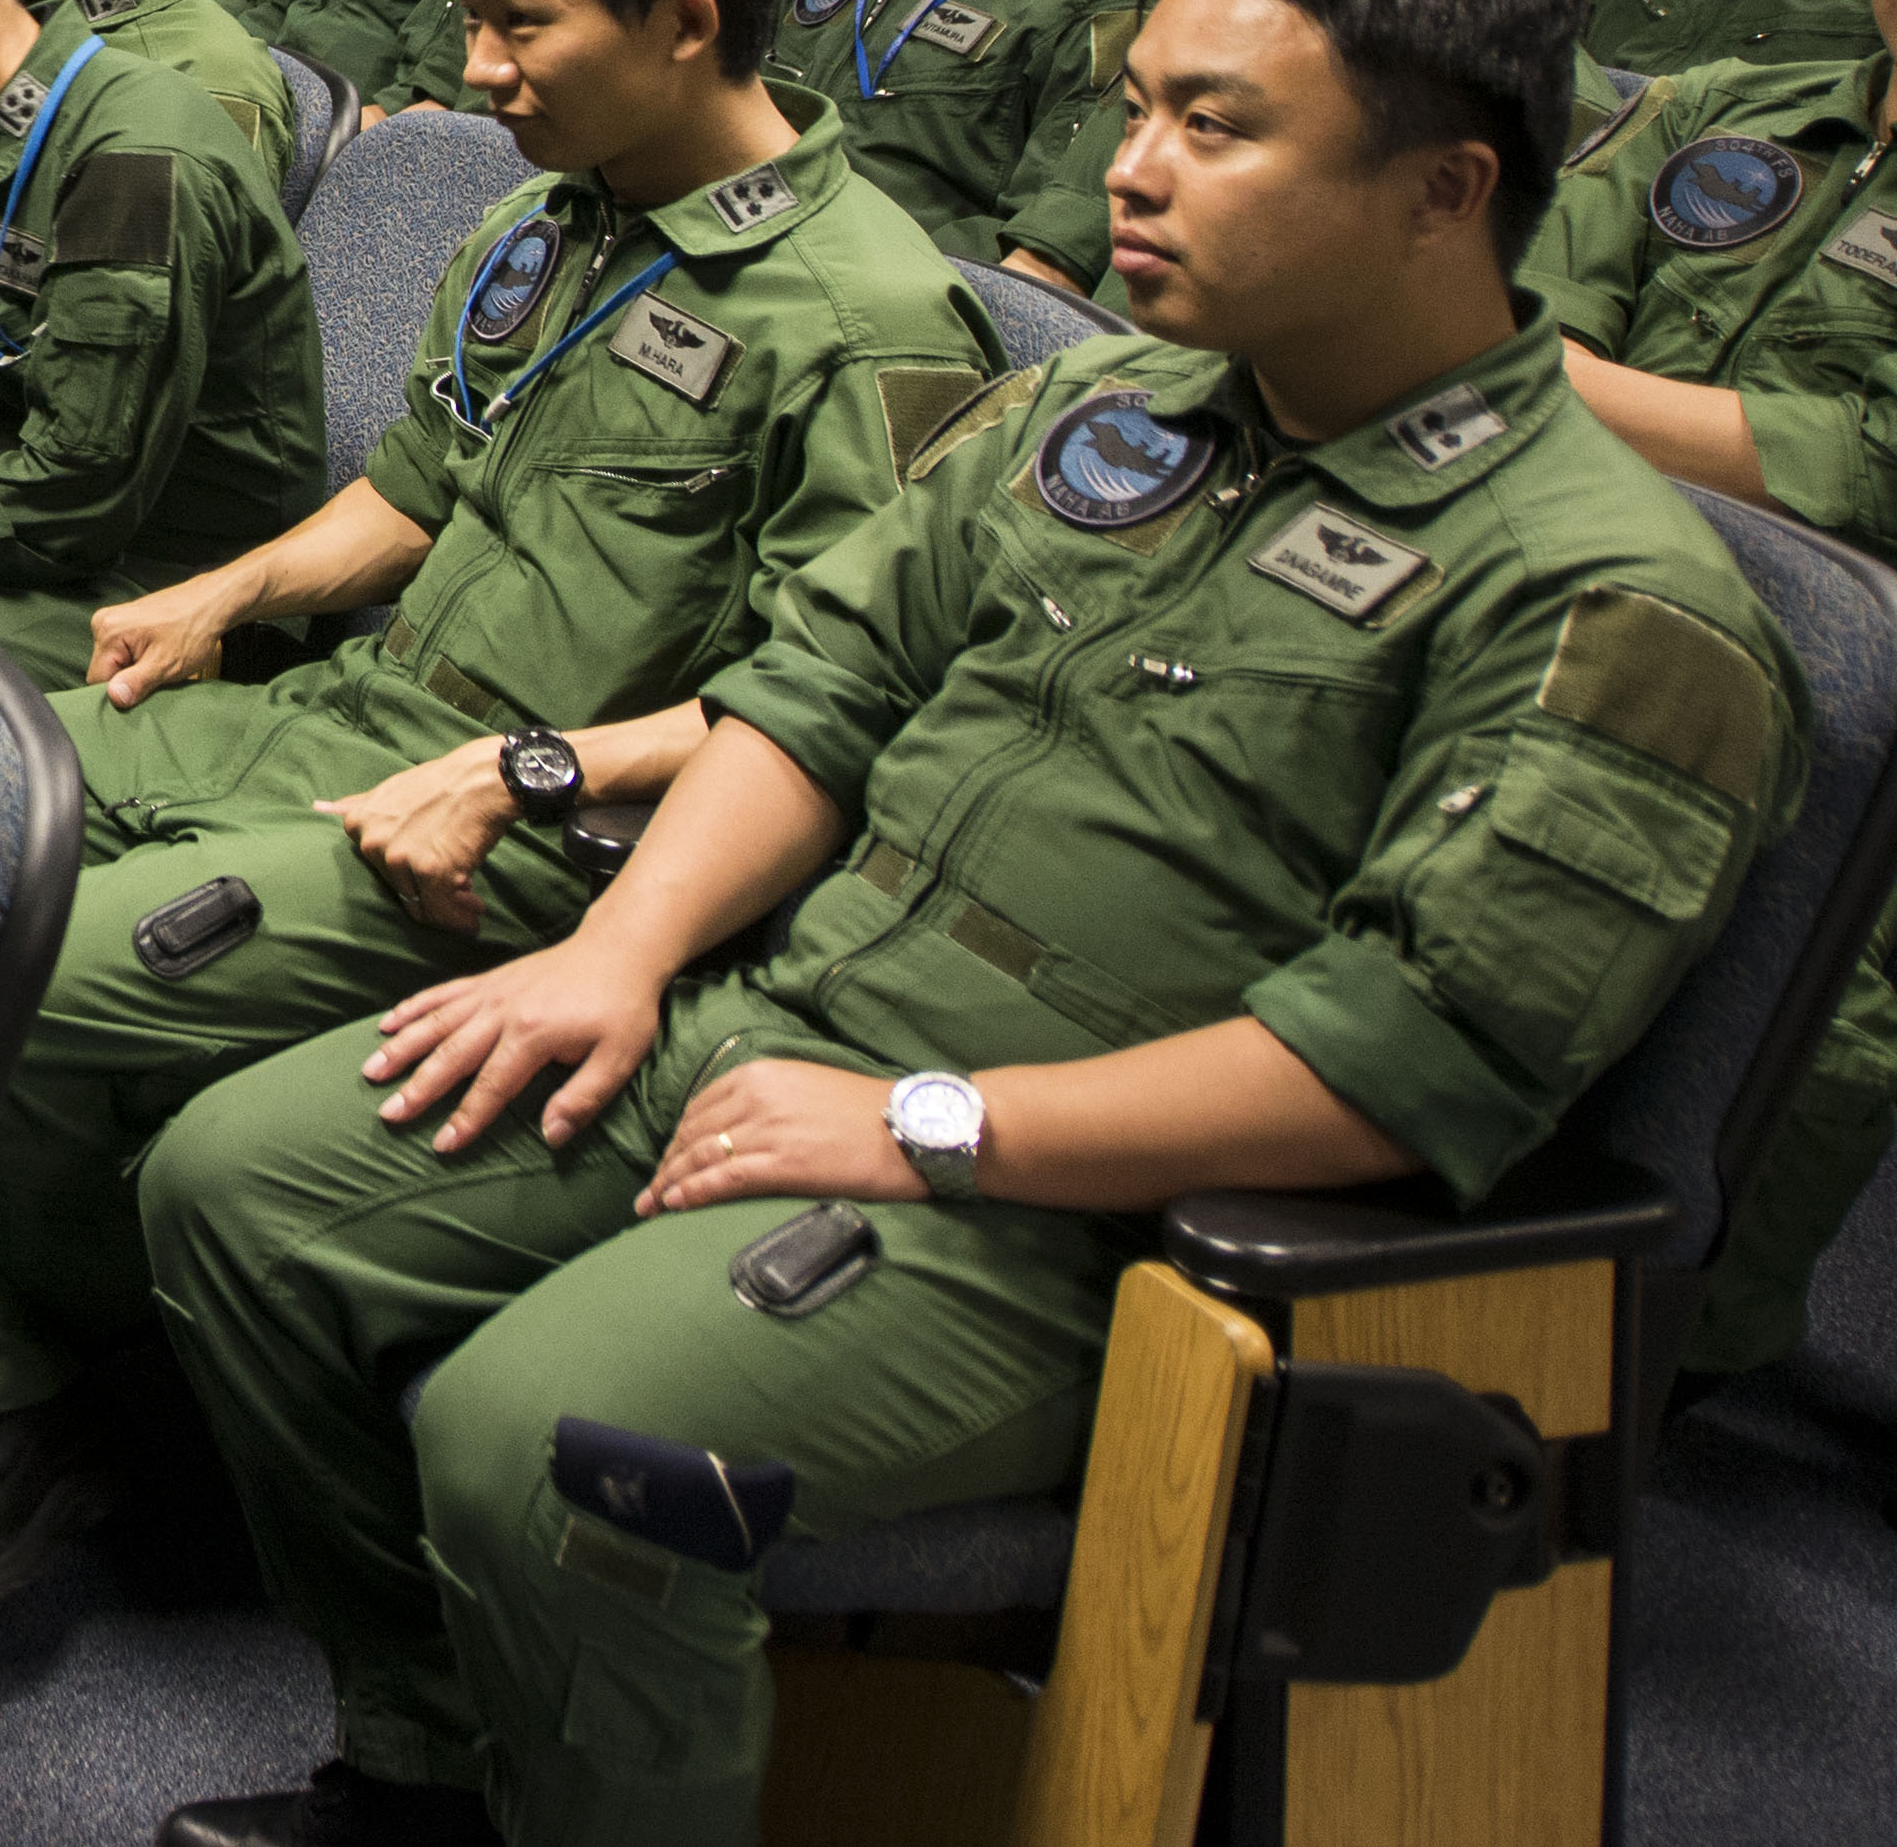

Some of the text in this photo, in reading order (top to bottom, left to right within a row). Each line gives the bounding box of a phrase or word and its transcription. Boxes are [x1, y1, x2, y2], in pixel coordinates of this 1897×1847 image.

[1657, 205, 1731, 243] NAHA AB
[638, 341, 685, 379] M.HARA
[1044, 474, 1131, 520] NAHA AB
